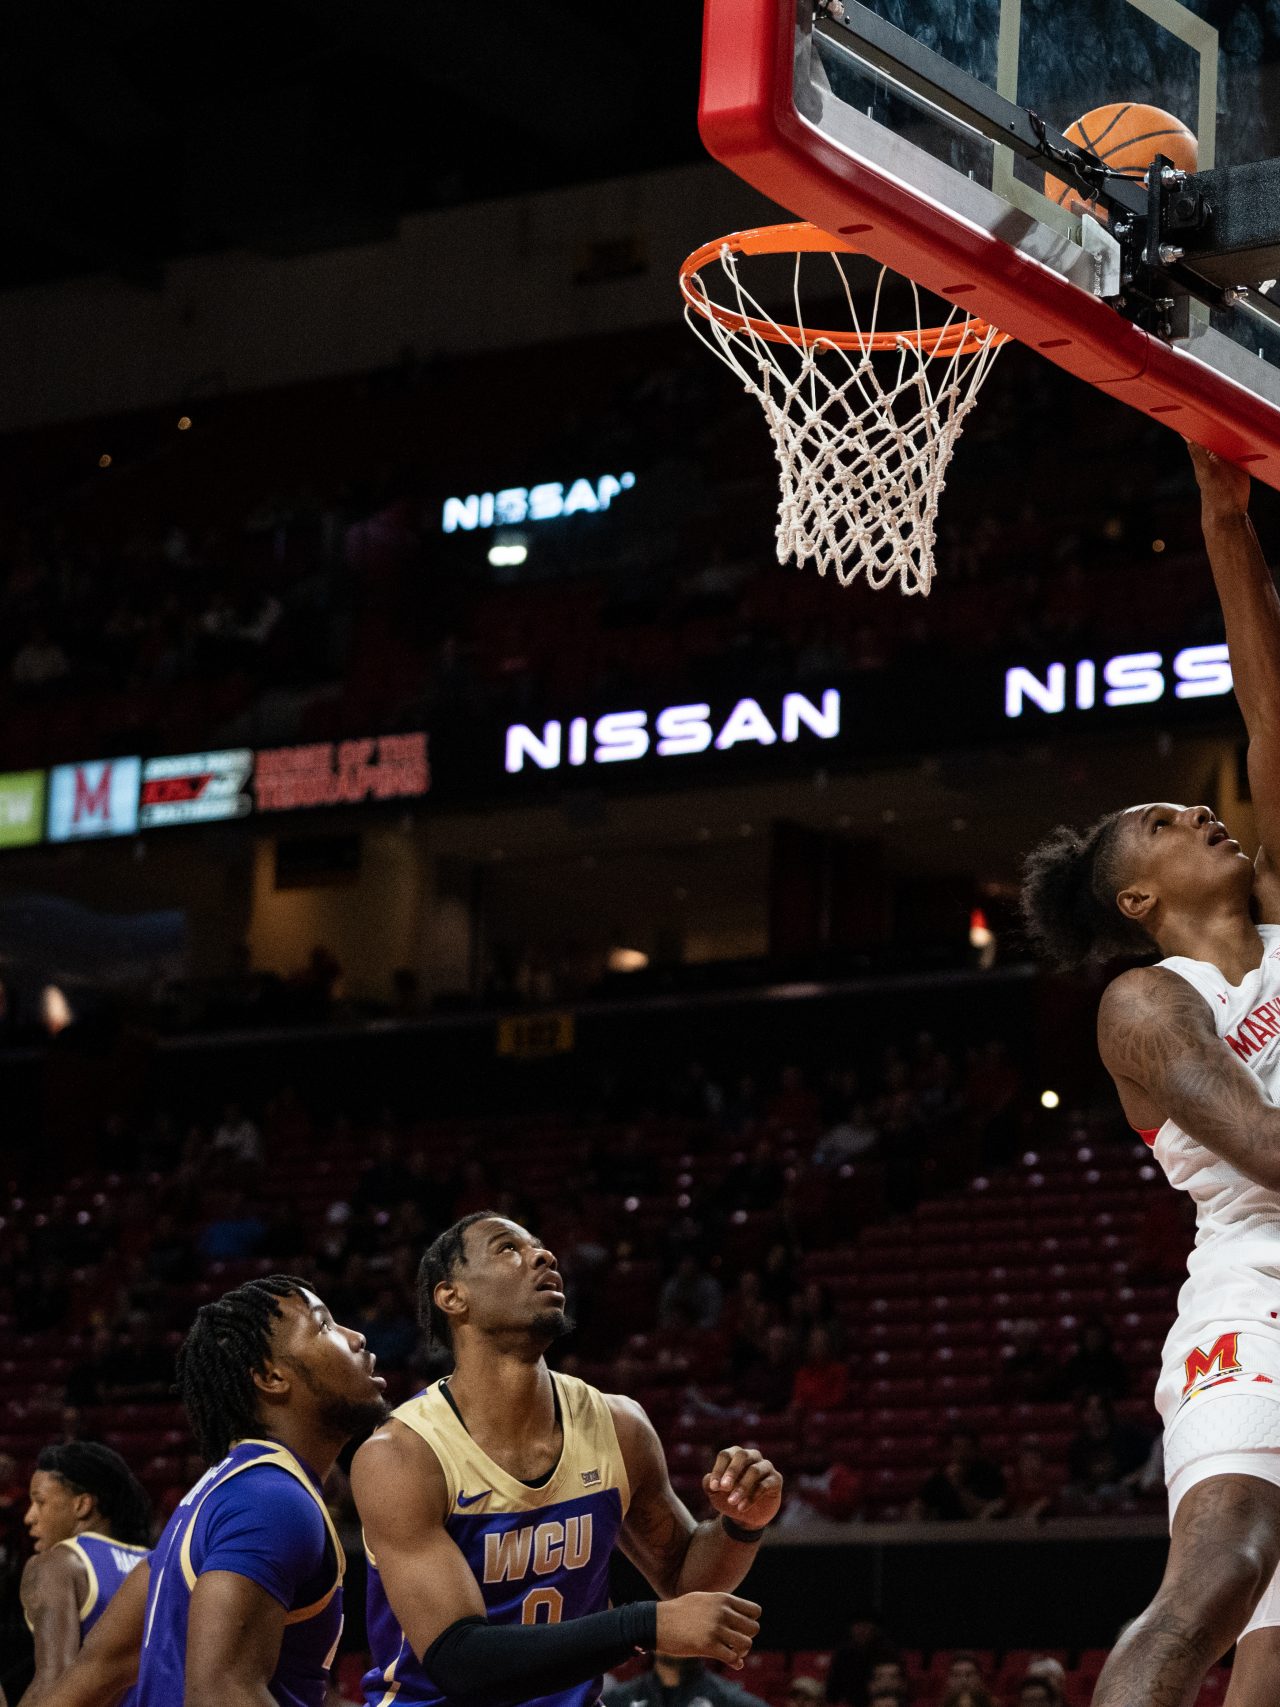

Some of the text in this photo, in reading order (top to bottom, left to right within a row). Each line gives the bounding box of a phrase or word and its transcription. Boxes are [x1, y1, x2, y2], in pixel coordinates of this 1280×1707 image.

[506, 689, 841, 774] NISSAN
[1181, 1332, 1242, 1399] M
[483, 1513, 593, 1584] WCU
